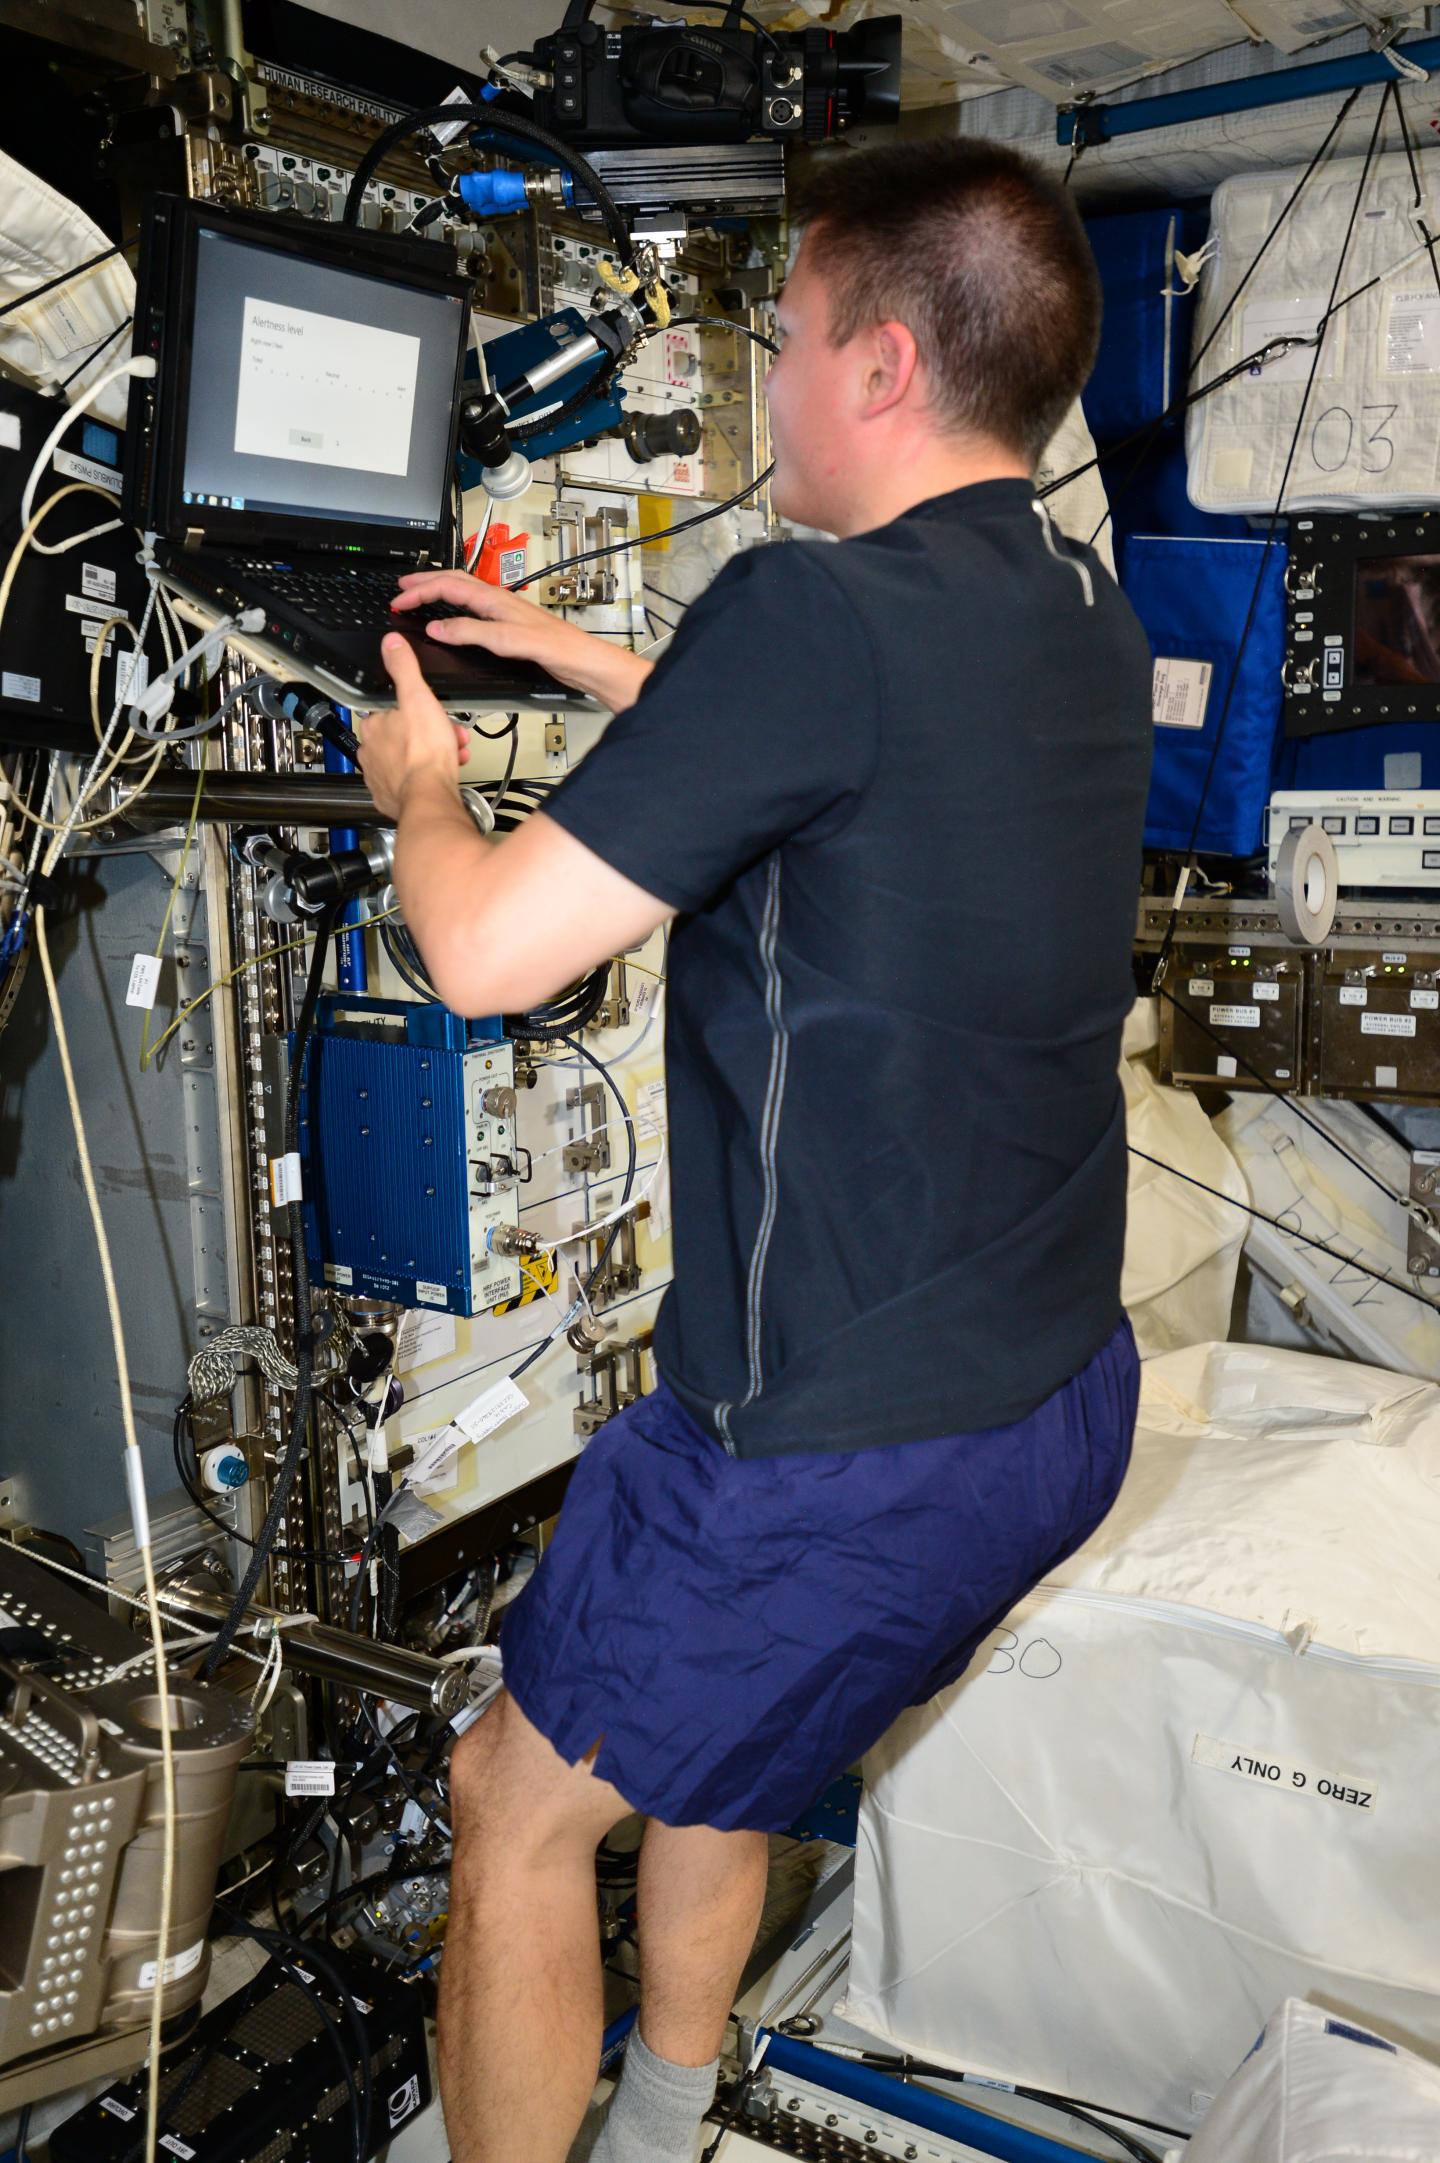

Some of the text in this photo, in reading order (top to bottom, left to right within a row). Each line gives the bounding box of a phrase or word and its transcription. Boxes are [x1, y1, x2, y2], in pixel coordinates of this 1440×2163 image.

[264, 67, 397, 125] HUMAN RESEARCH FACILITY
[252, 315, 304, 336] Alertness level
[1311, 404, 1399, 473] 03
[484, 1283, 510, 1298] INTERFACE
[494, 1276, 511, 1287] POWER
[486, 1295, 497, 1304] UNIT
[1231, 1755, 1372, 1808] ZERO G ONLY
